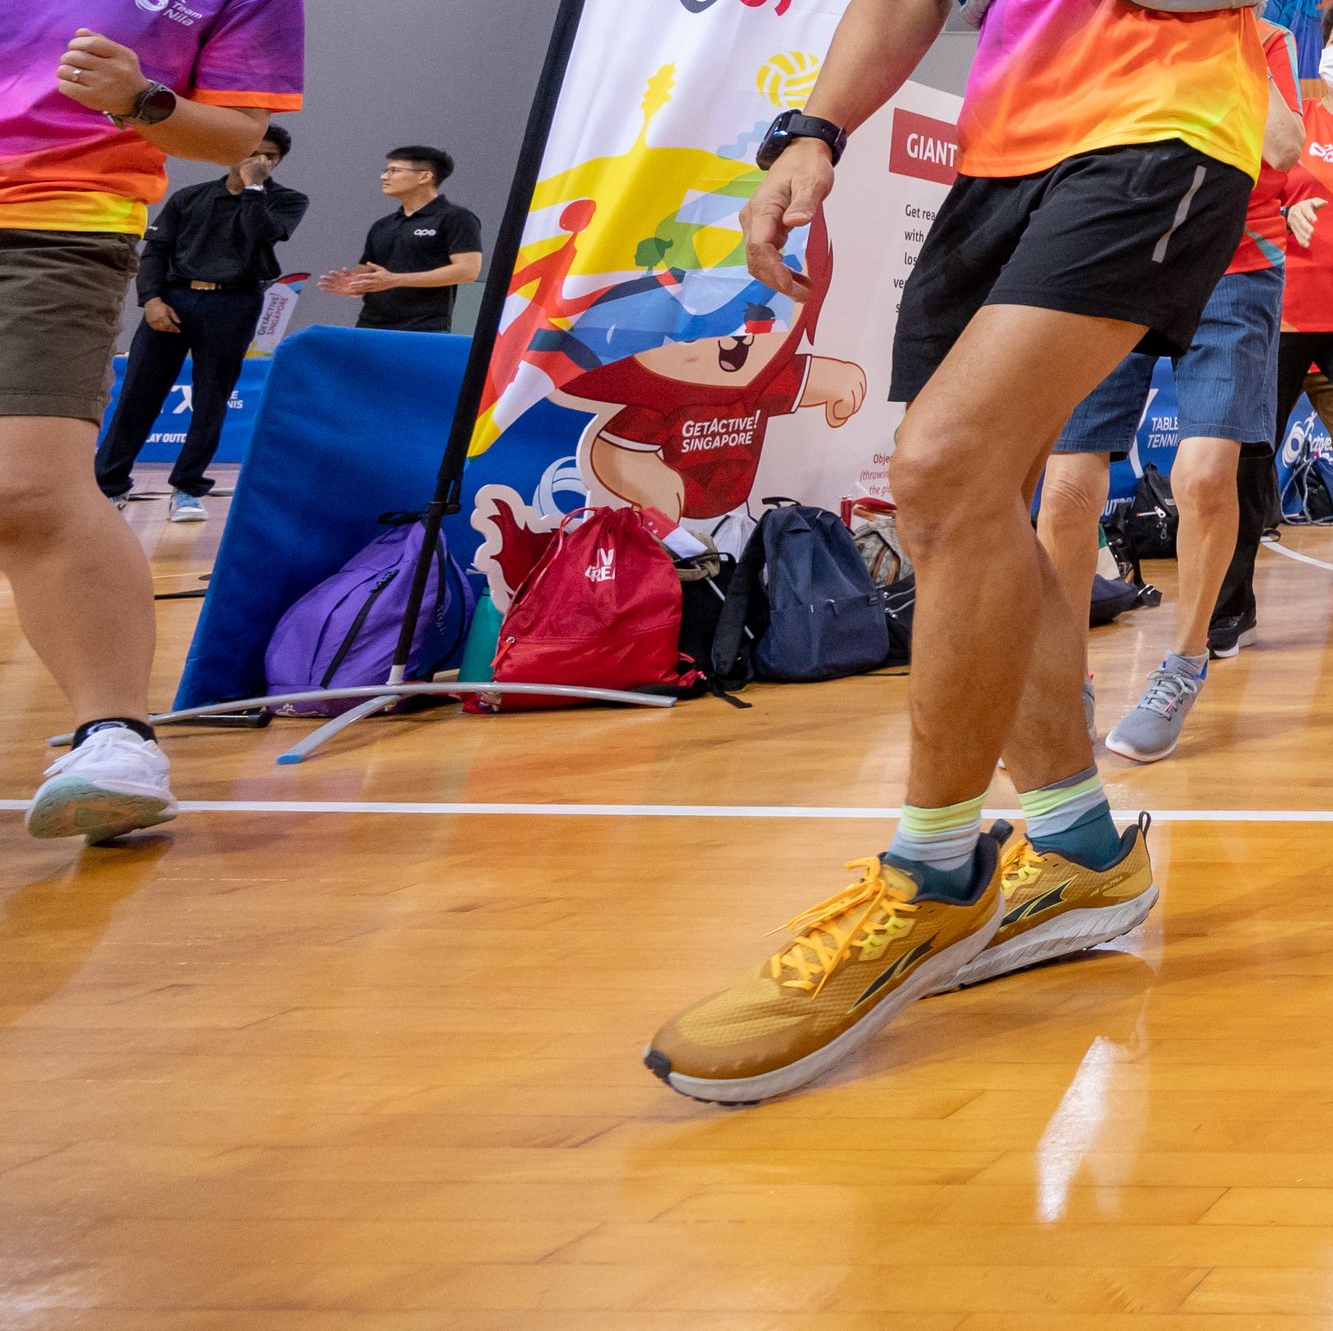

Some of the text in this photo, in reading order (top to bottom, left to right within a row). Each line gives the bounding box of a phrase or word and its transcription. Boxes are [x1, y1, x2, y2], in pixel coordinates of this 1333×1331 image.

[162, 8, 194, 27] Nila
[173, 1, 203, 19] Team
[906, 133, 958, 168] GIANT
[905, 204, 920, 218] Get
[904, 229, 924, 243] with
[1152, 416, 1179, 431] TABLE
[681, 431, 754, 453] SINGAPORE
[1147, 433, 1179, 448] TENNI
[869, 486, 880, 495] the
